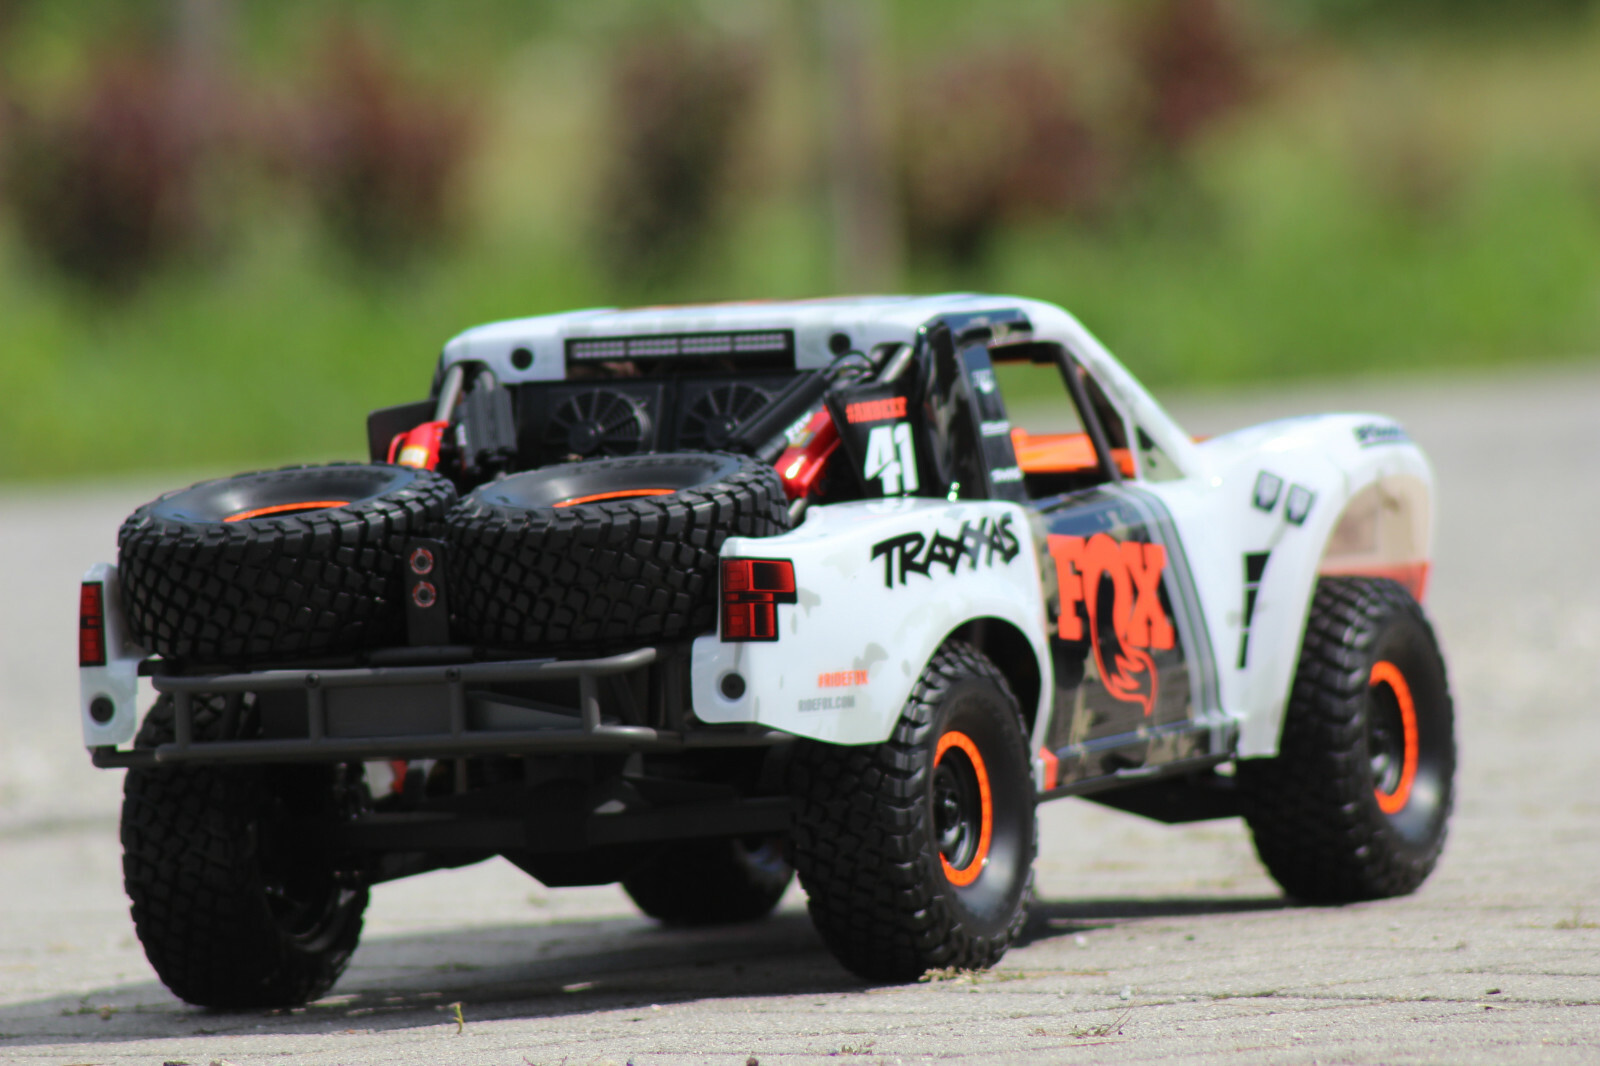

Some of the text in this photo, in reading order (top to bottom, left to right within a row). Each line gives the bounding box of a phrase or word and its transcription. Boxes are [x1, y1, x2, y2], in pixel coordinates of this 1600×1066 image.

[864, 422, 919, 496] 41
[870, 511, 1020, 589] TRAXXAS
[1046, 532, 1176, 717] FOX
[797, 694, 856, 713] RIDEFOX.COM
[817, 669, 869, 688] #RIDEFOX
